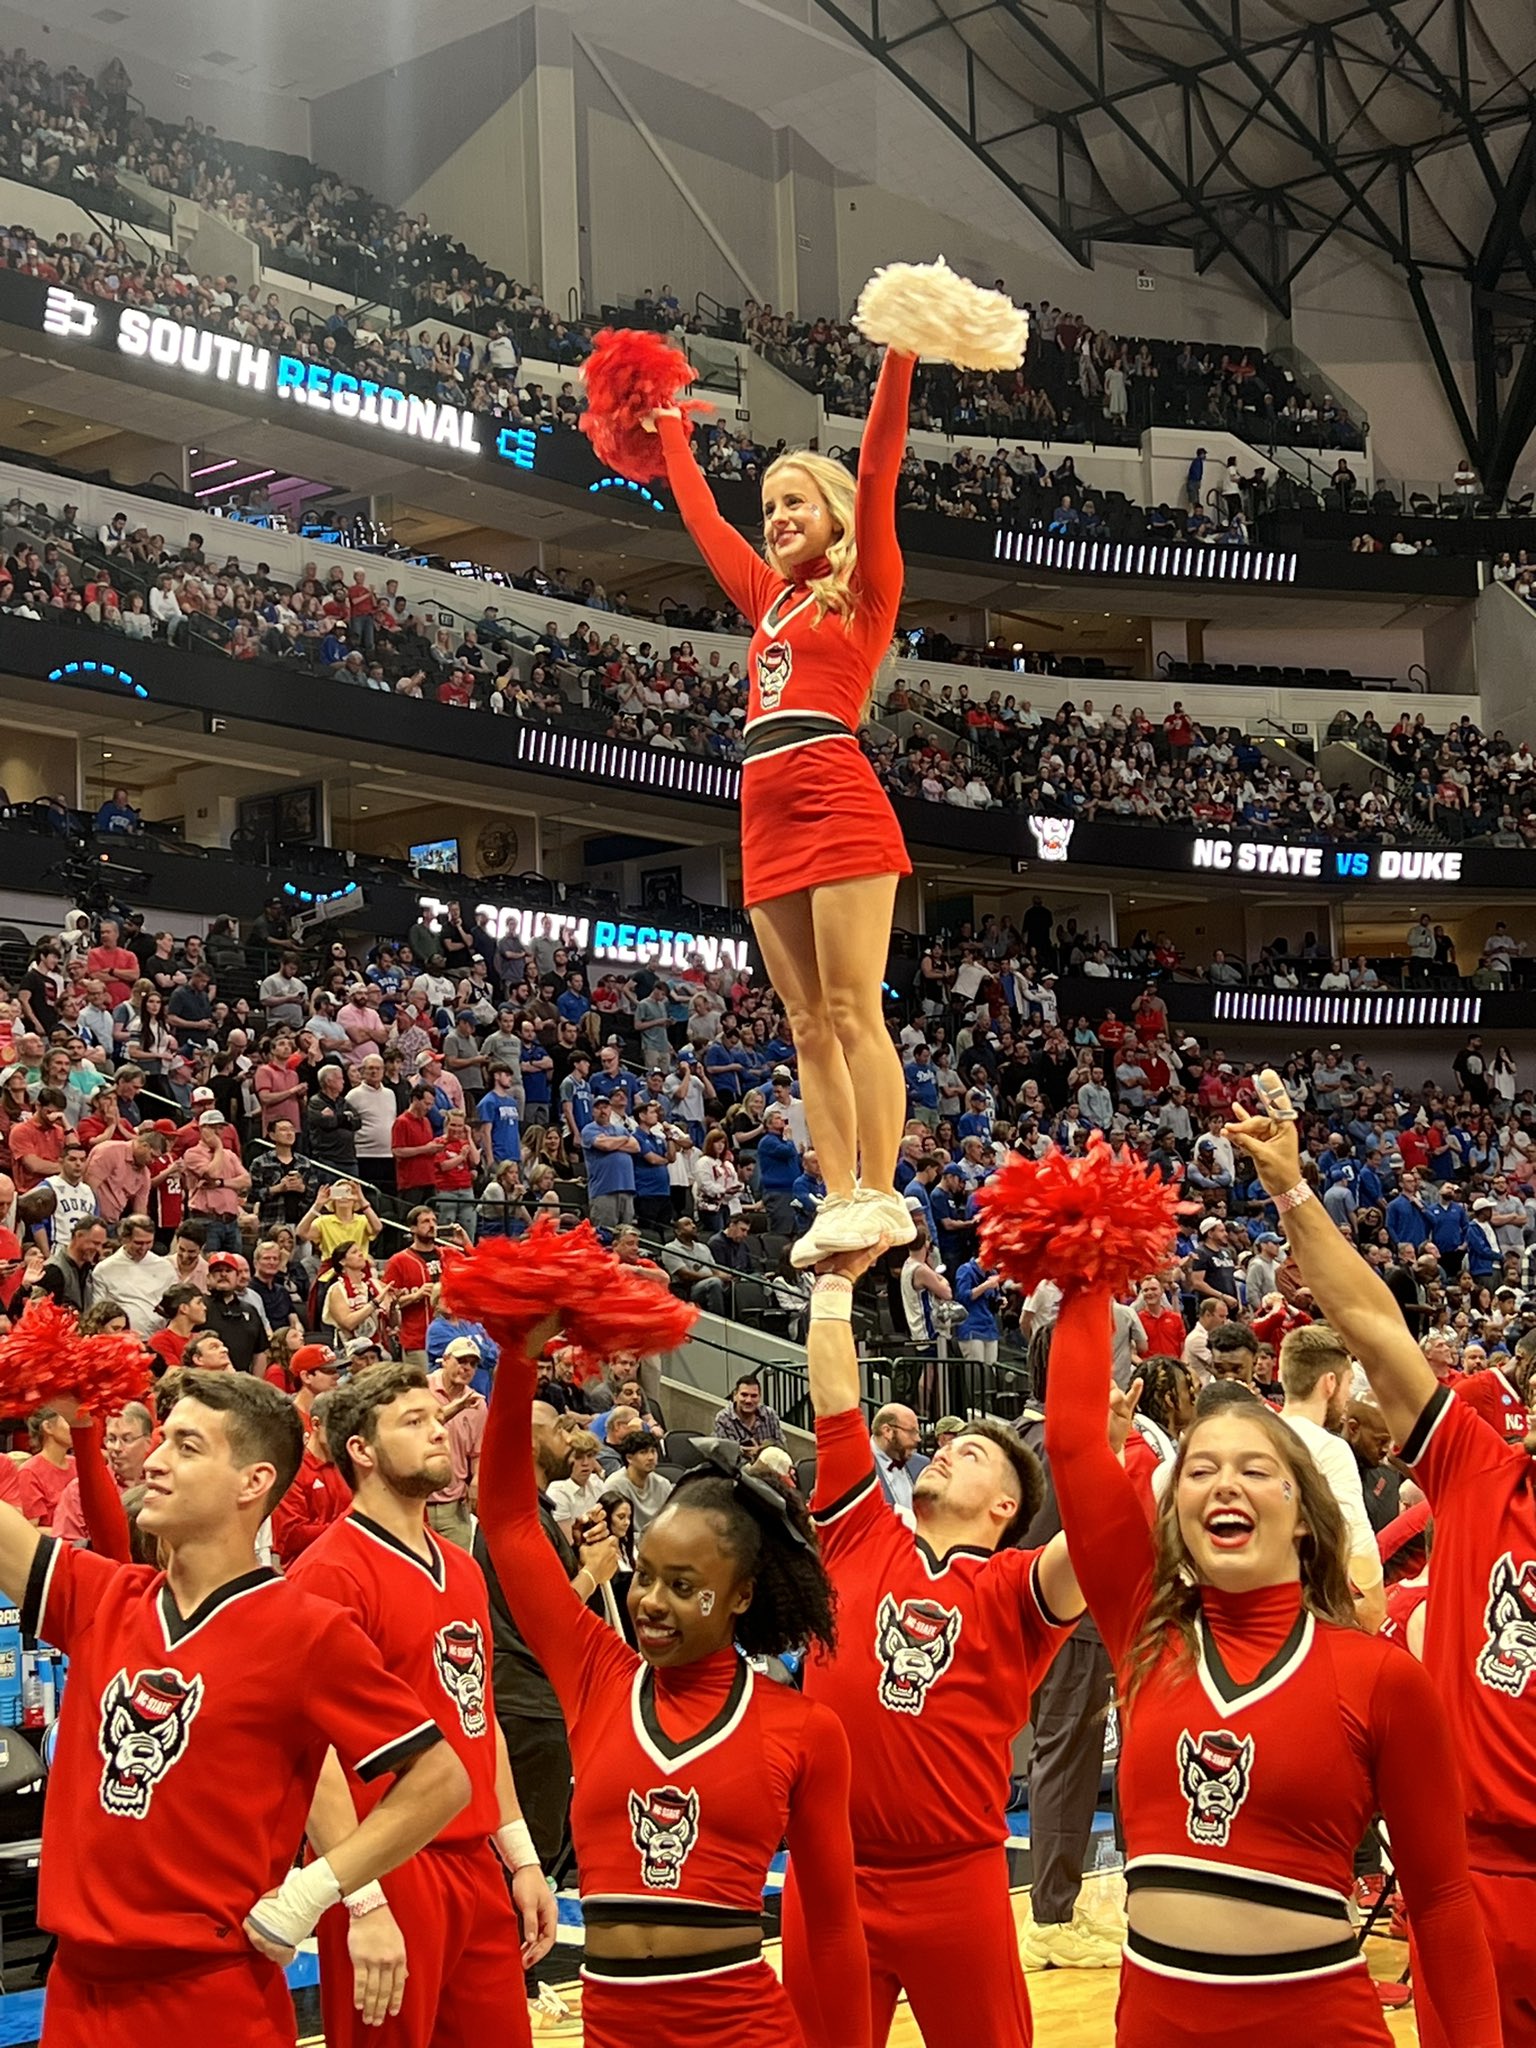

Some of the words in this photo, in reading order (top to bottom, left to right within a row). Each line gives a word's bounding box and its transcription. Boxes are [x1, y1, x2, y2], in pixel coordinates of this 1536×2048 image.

[1138, 278, 1154, 289] 331
[117, 307, 271, 391] SOUTH
[276, 354, 481, 453] REGIONAL
[211, 718, 227, 733] F
[1192, 838, 1233, 869] NC
[1237, 843, 1323, 876] STATE
[1336, 852, 1369, 876] VS
[1379, 851, 1463, 880] DUKE
[594, 920, 754, 975] REGIONAL
[1505, 1413, 1525, 1431] NC
[914, 1620, 938, 1638] STATE
[134, 1689, 150, 1708] NC
[145, 1697, 173, 1717] STATE
